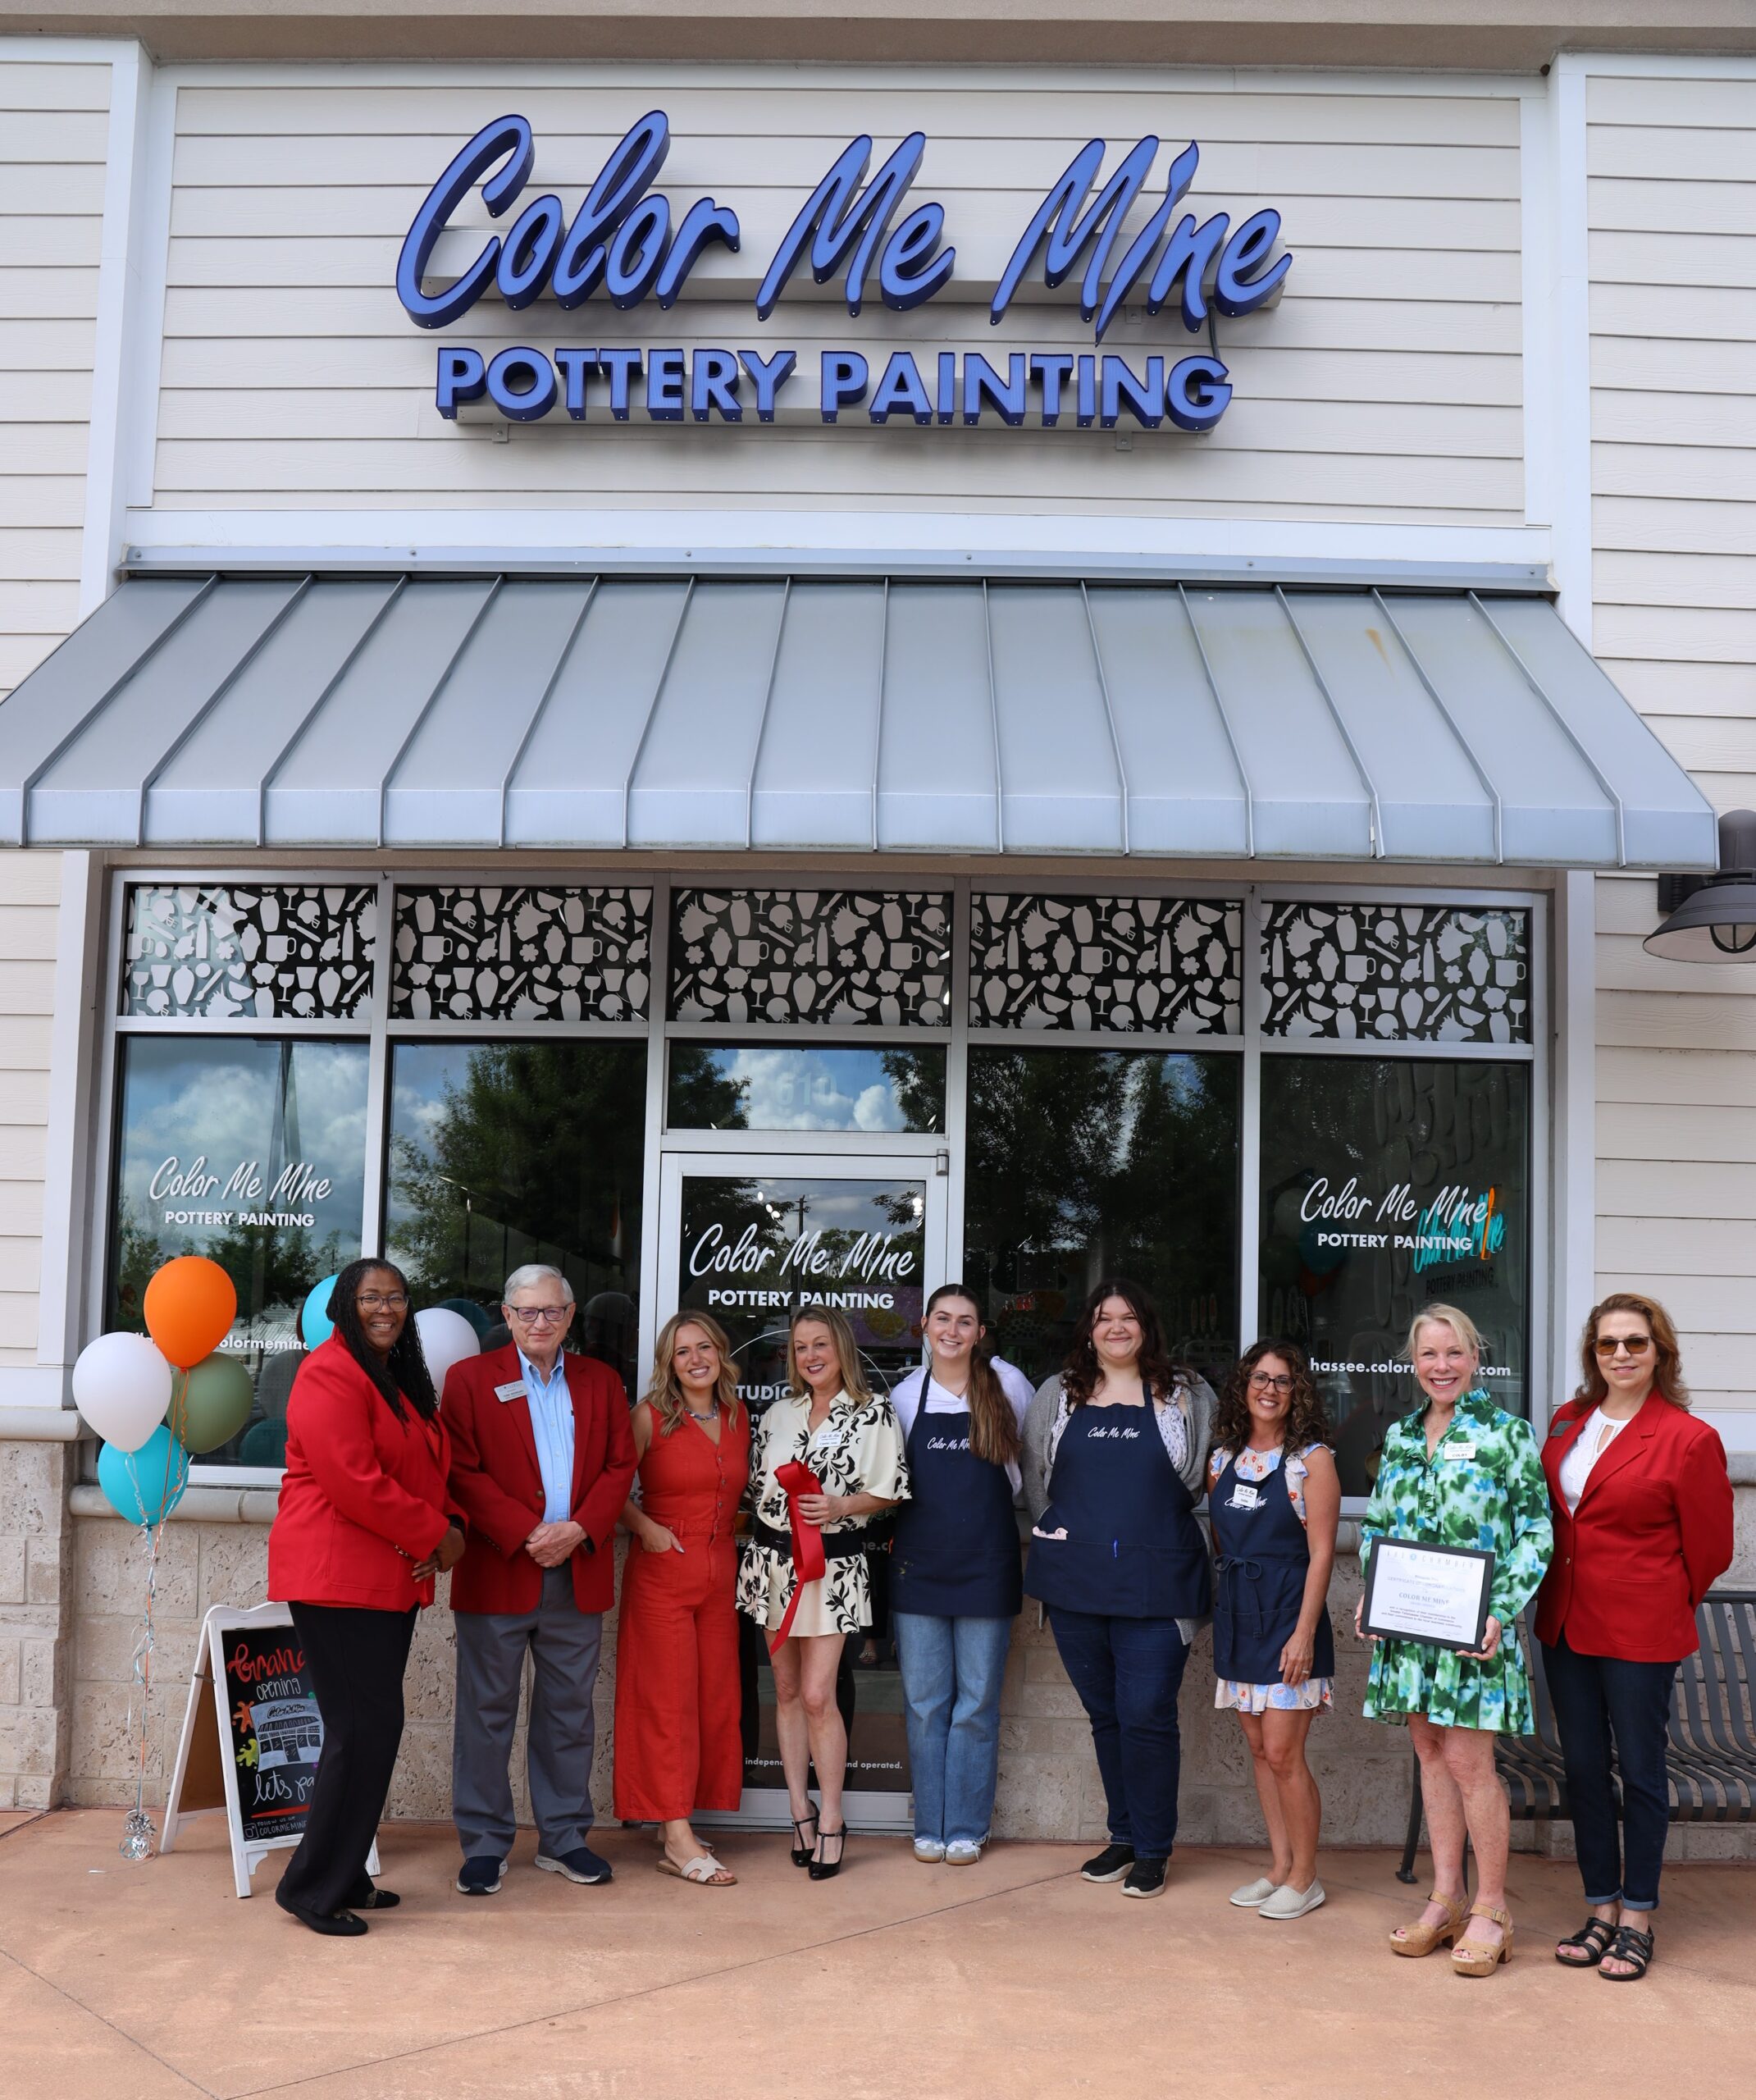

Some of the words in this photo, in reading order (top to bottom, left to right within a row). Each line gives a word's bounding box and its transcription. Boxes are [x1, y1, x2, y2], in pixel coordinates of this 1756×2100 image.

[396, 109, 741, 329] Color
[755, 131, 956, 322] Me
[989, 134, 1293, 348] Mine
[436, 345, 797, 422] POTTERY
[821, 350, 1234, 432] PAINTING
[149, 1156, 219, 1199] Color
[221, 1161, 262, 1199] Me
[269, 1162, 331, 1205] Mine
[1301, 1177, 1372, 1222] Color
[1375, 1183, 1417, 1222] Me
[1425, 1185, 1489, 1229] Mine
[165, 1211, 233, 1226] POTTERY
[239, 1212, 314, 1226] PAINTING
[1317, 1233, 1389, 1248] POTTERY
[1394, 1235, 1472, 1250] PAINTING
[689, 1223, 775, 1276] Color
[779, 1230, 828, 1276] Me
[838, 1231, 915, 1283] Mine
[709, 1290, 793, 1306] POTTERY
[800, 1292, 894, 1309] PAINTING
[1088, 1427, 1107, 1437] Color
[1107, 1427, 1120, 1438] Me
[1120, 1427, 1140, 1440] Mine
[927, 1436, 946, 1449] Color
[946, 1439, 957, 1450] Me
[1398, 1591, 1421, 1601] COLOR
[860, 1760, 903, 1770] operated.
